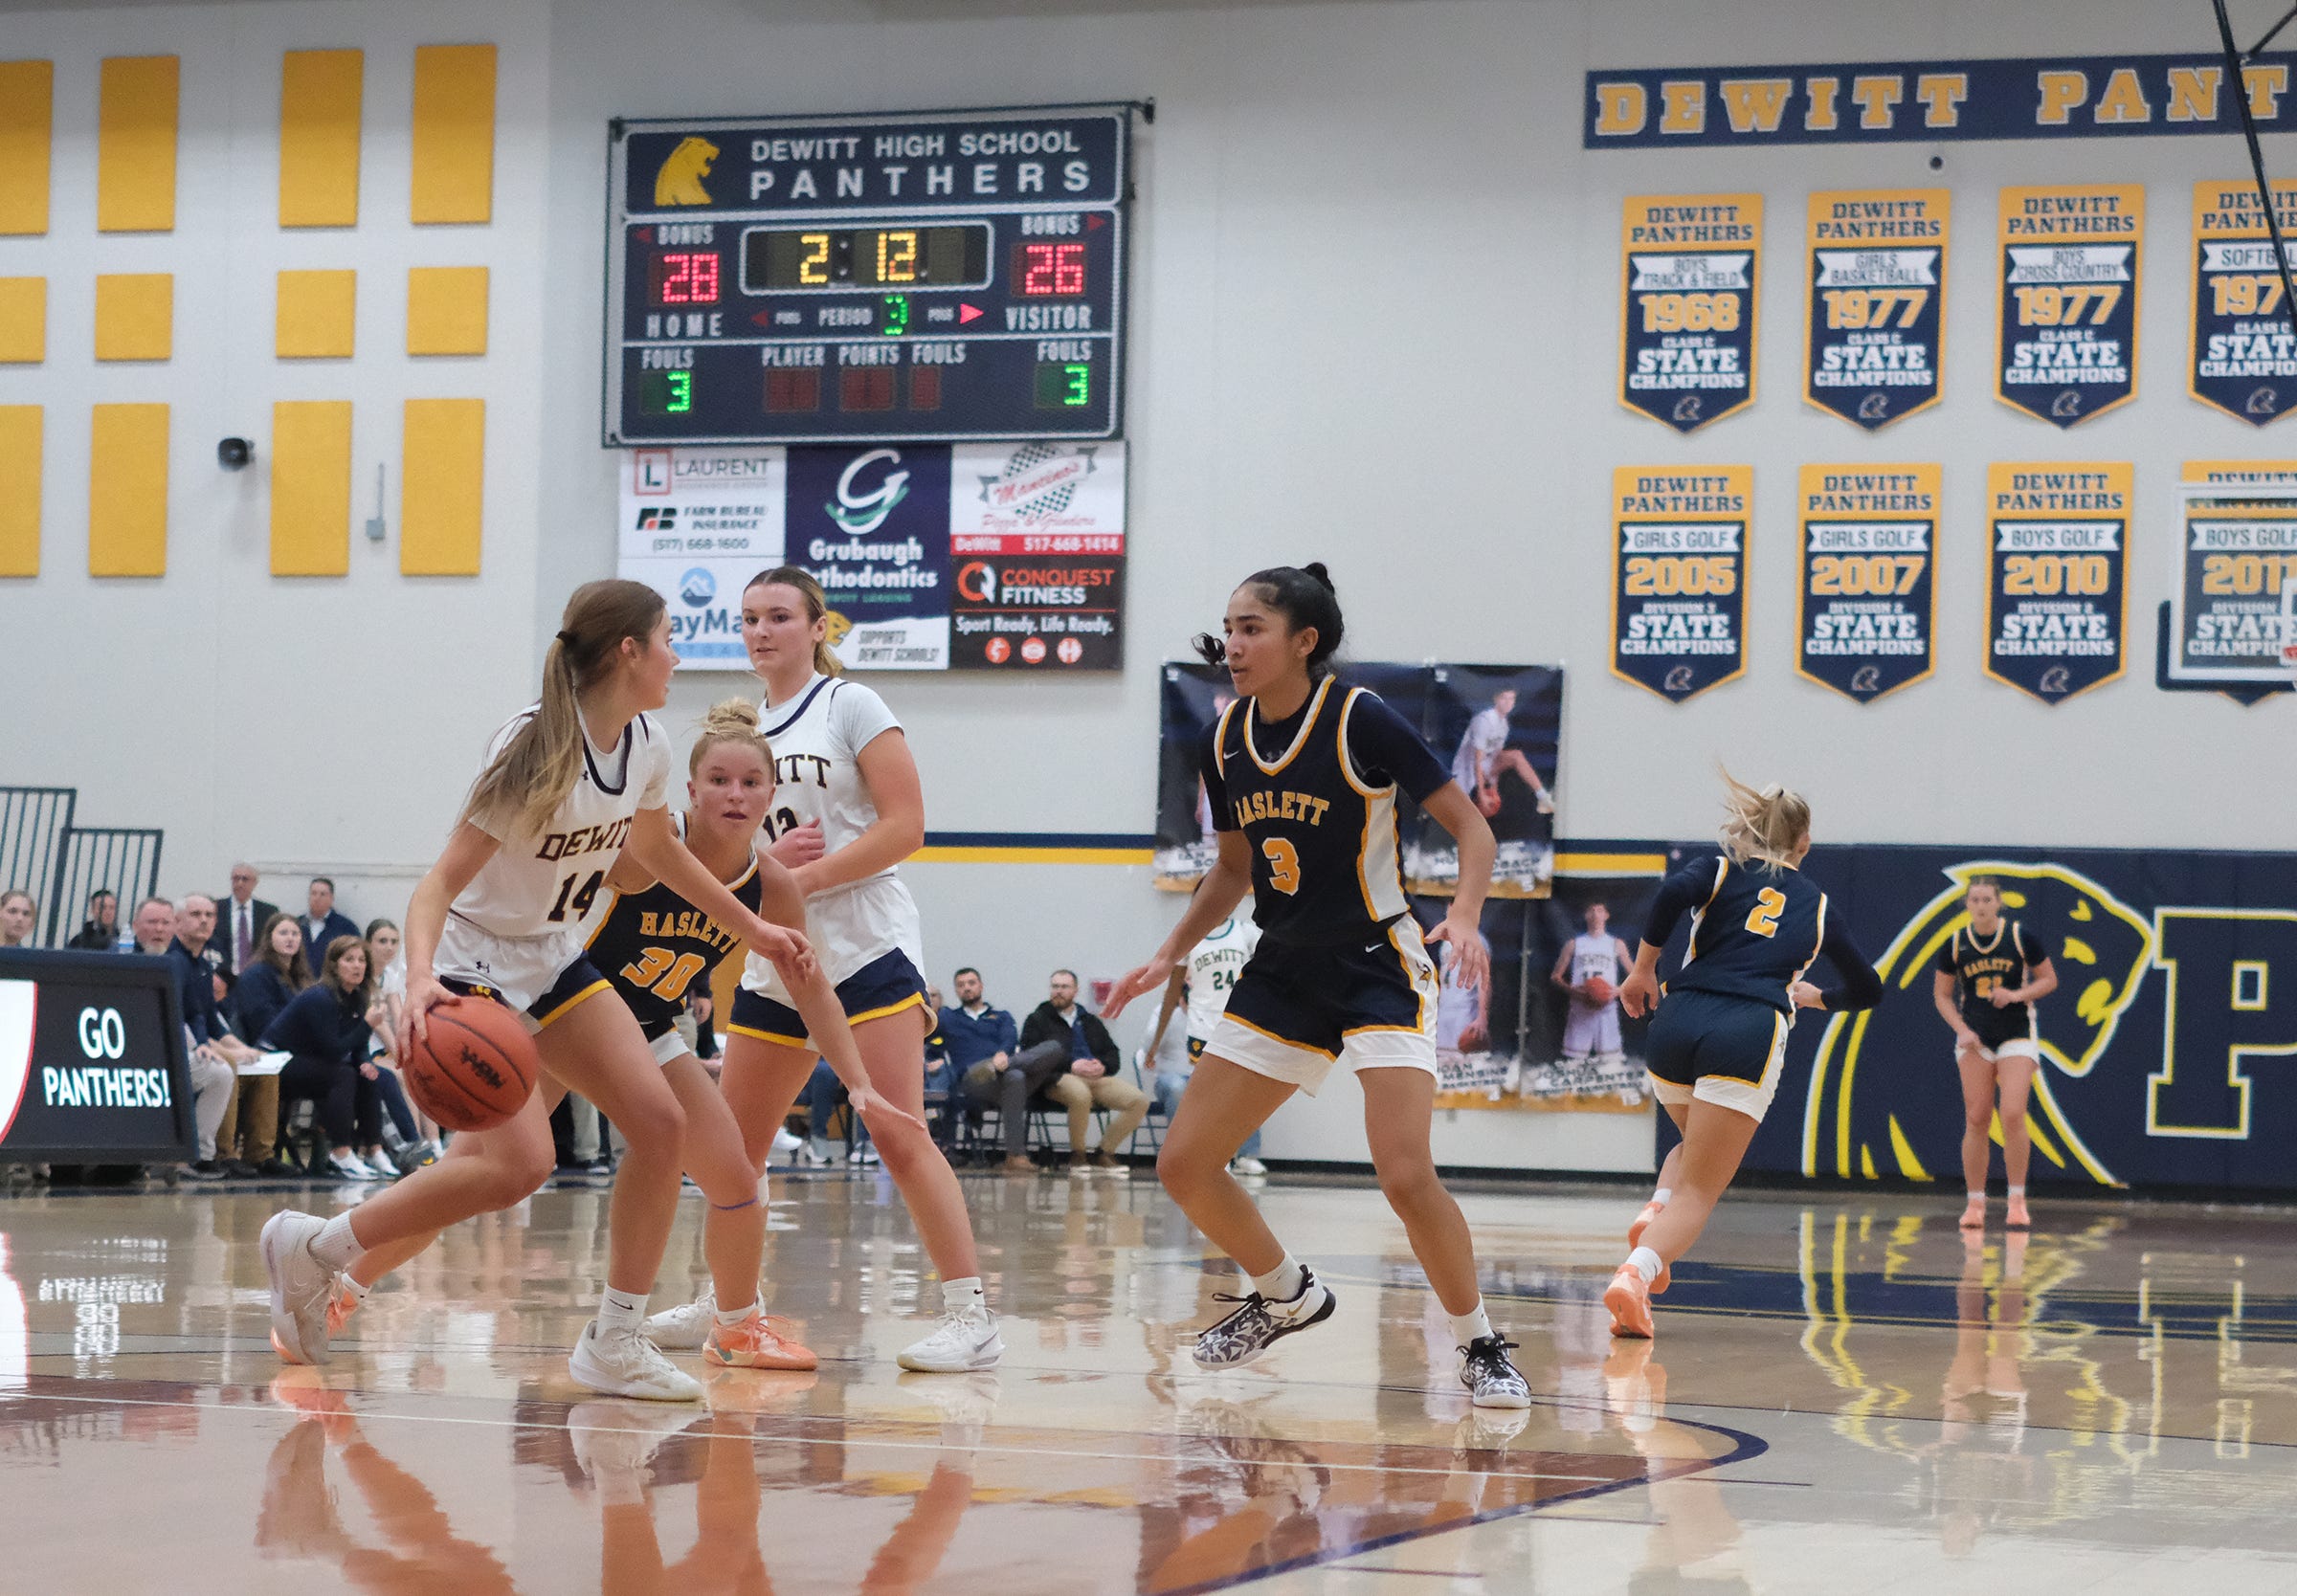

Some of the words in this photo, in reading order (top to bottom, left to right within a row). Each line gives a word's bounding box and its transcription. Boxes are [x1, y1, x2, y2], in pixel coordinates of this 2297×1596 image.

[1595, 74, 1968, 136] DEWITT
[2036, 65, 2288, 124] PANT
[750, 138, 860, 162] DEWITT
[875, 134, 946, 158] HIGH
[959, 131, 1082, 155] SCHOOL
[749, 161, 1090, 200] PANTHERS
[1647, 206, 1738, 223] DEWITT
[1832, 200, 1928, 219] DEWITT
[2023, 196, 2121, 214] DEWITT
[658, 225, 714, 245] BONUS
[1021, 214, 1081, 235] BONUS
[1632, 225, 1752, 242] PANTHERS
[1817, 220, 1941, 238] PANTHERS
[2008, 216, 2135, 233] PANTHERS
[1674, 258, 1708, 272] BOYS
[1856, 254, 1898, 268] GIRLS
[2053, 250, 2085, 264] BOYS
[2221, 248, 2297, 266] SOFTBL
[663, 253, 719, 302] 28
[1025, 245, 1084, 294] 26
[1643, 274, 1684, 287] TRACK
[1703, 273, 1738, 286] FIELD
[1830, 269, 1921, 284] BASKETBALL
[2017, 265, 2058, 280] CROSS
[2063, 264, 2119, 279] COUNTRY
[2013, 285, 2122, 326] 1977
[2209, 274, 2297, 316] 197
[818, 307, 873, 326] PERIOD
[1006, 304, 1092, 330] VISITOR
[1639, 293, 1741, 333] 1968
[1822, 289, 1929, 329] 1977
[646, 313, 723, 337] HOME
[642, 348, 694, 369] FOULS
[762, 345, 825, 367] PLAYER
[838, 344, 901, 366] POINTS
[911, 343, 967, 365] FOULS
[1037, 340, 1093, 362] FOULS
[1822, 344, 1926, 370] STATE
[2014, 341, 2121, 367] STATE
[2208, 335, 2297, 361] STAT
[1637, 347, 1739, 373] STATE
[1064, 365, 1088, 406] 3
[1629, 373, 1746, 389] CHAMPIONS
[1815, 370, 1932, 387] CHAMPIONS
[2005, 366, 2127, 384] CHAMPIONS
[667, 370, 690, 412] 3
[674, 458, 769, 476] LAURENT
[1638, 477, 1729, 494] DEWITT
[1824, 475, 1918, 493] DEWITT
[2013, 475, 2109, 492] DEWITT
[1622, 496, 1743, 512] PANTHERS
[1808, 494, 1931, 511] PANTHERS
[1996, 494, 2123, 511] PANTHERS
[687, 538, 749, 550] 668-1600
[1634, 531, 1680, 548] GIRLS
[1686, 531, 1728, 548] GOLF
[1820, 531, 1866, 547] GIRLS
[1874, 530, 1915, 547] GOLF
[2011, 530, 2055, 546] BOYS
[2061, 529, 2105, 546] GOLF
[2205, 529, 2250, 545] BOYS
[809, 537, 924, 565] Grubaugh
[1001, 569, 1115, 586] CONQUEST
[1625, 556, 1736, 596] 2005
[1811, 555, 1925, 596] 2007
[2003, 555, 2109, 595] 2010
[1002, 587, 1086, 605] FITNESS
[671, 609, 743, 641] ayMa
[956, 615, 992, 635] Sport
[993, 615, 1038, 635] Ready.
[1041, 616, 1065, 632] Life
[1068, 615, 1113, 636] Ready.
[1628, 613, 1729, 639] STATE
[1815, 613, 1917, 639] STATE
[2003, 613, 2107, 639] STATE
[2197, 614, 2297, 639] STAT
[859, 631, 906, 644] SUPPORTS
[1620, 639, 1736, 654] CHAMPIONS
[1806, 639, 1925, 655] CHAMPIONS
[1995, 639, 2114, 655] CHAMPIONS
[859, 649, 893, 662] DEWITT
[1262, 837, 1301, 896] 3
[547, 870, 605, 922] 14
[1745, 887, 1787, 938] 2
[640, 911, 742, 954] HASLETT
[1194, 949, 1244, 972] DEWITT
[619, 947, 706, 1002] 30
[1213, 969, 1235, 990] 24
[78, 1007, 125, 1059] GO
[42, 1066, 171, 1108] PANTHERS!
